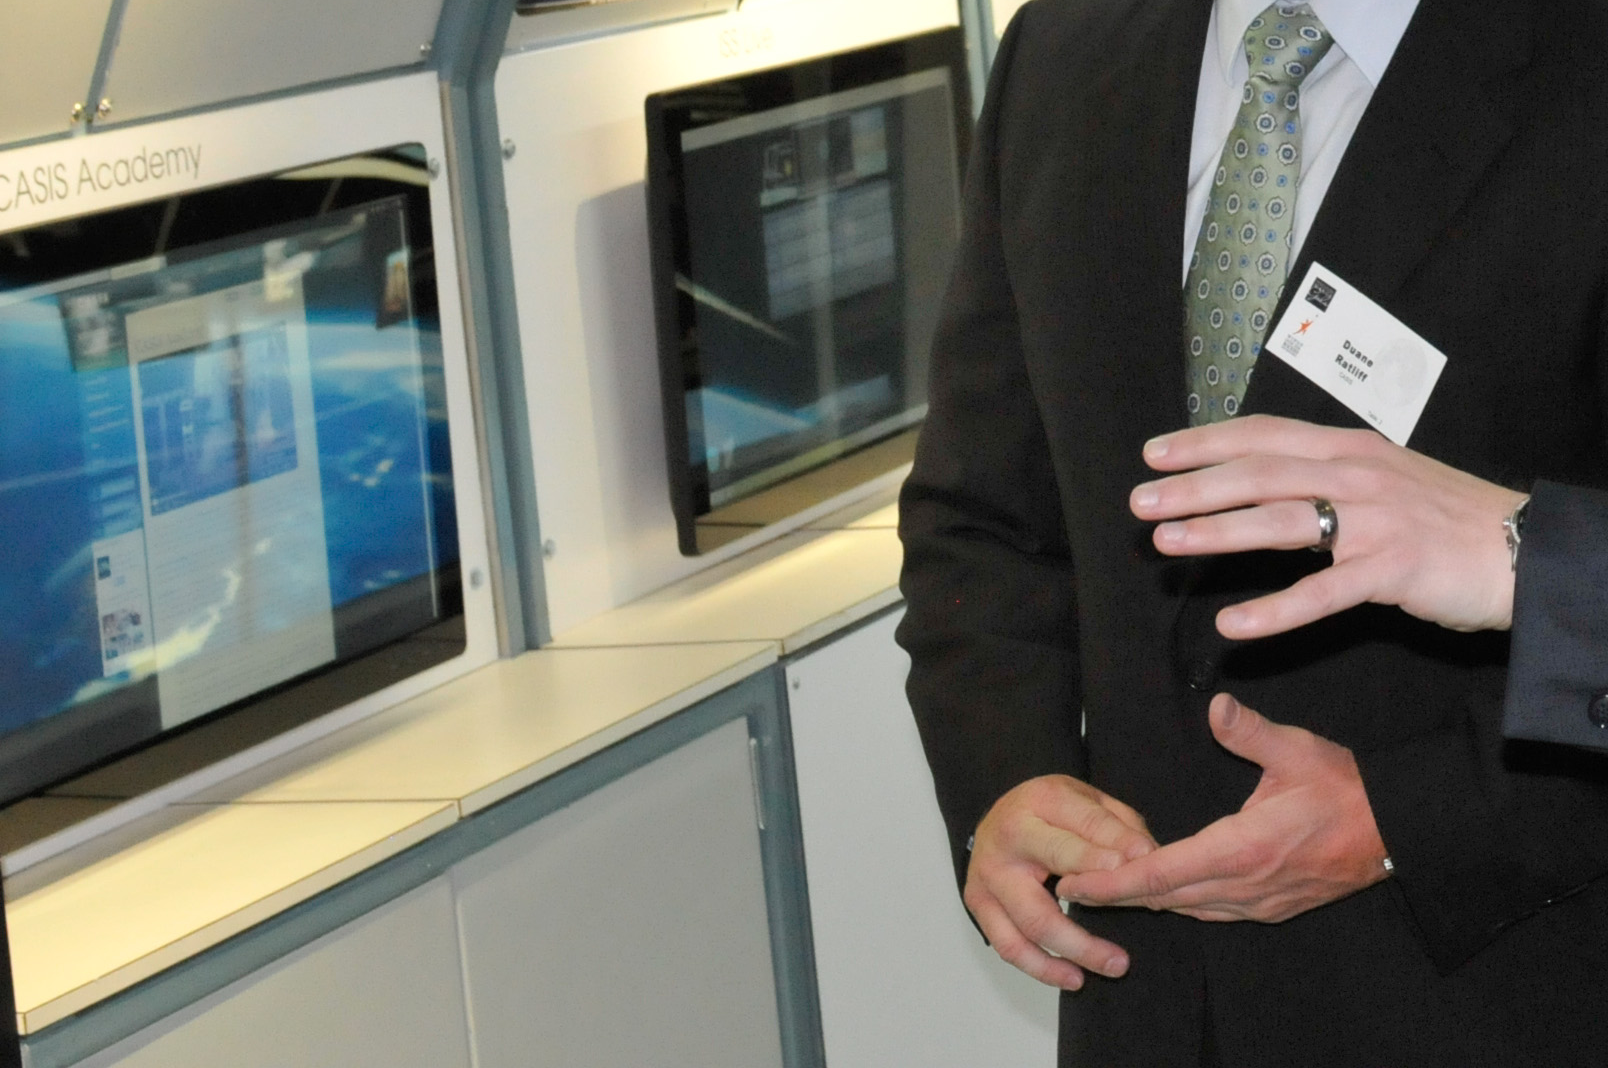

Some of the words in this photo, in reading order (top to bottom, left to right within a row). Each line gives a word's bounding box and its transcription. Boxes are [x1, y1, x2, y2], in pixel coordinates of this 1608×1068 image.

[0, 162, 69, 212] CASIS
[77, 143, 202, 196] Academy
[1342, 339, 1374, 368] Duane
[1334, 354, 1368, 383] Ratliff
